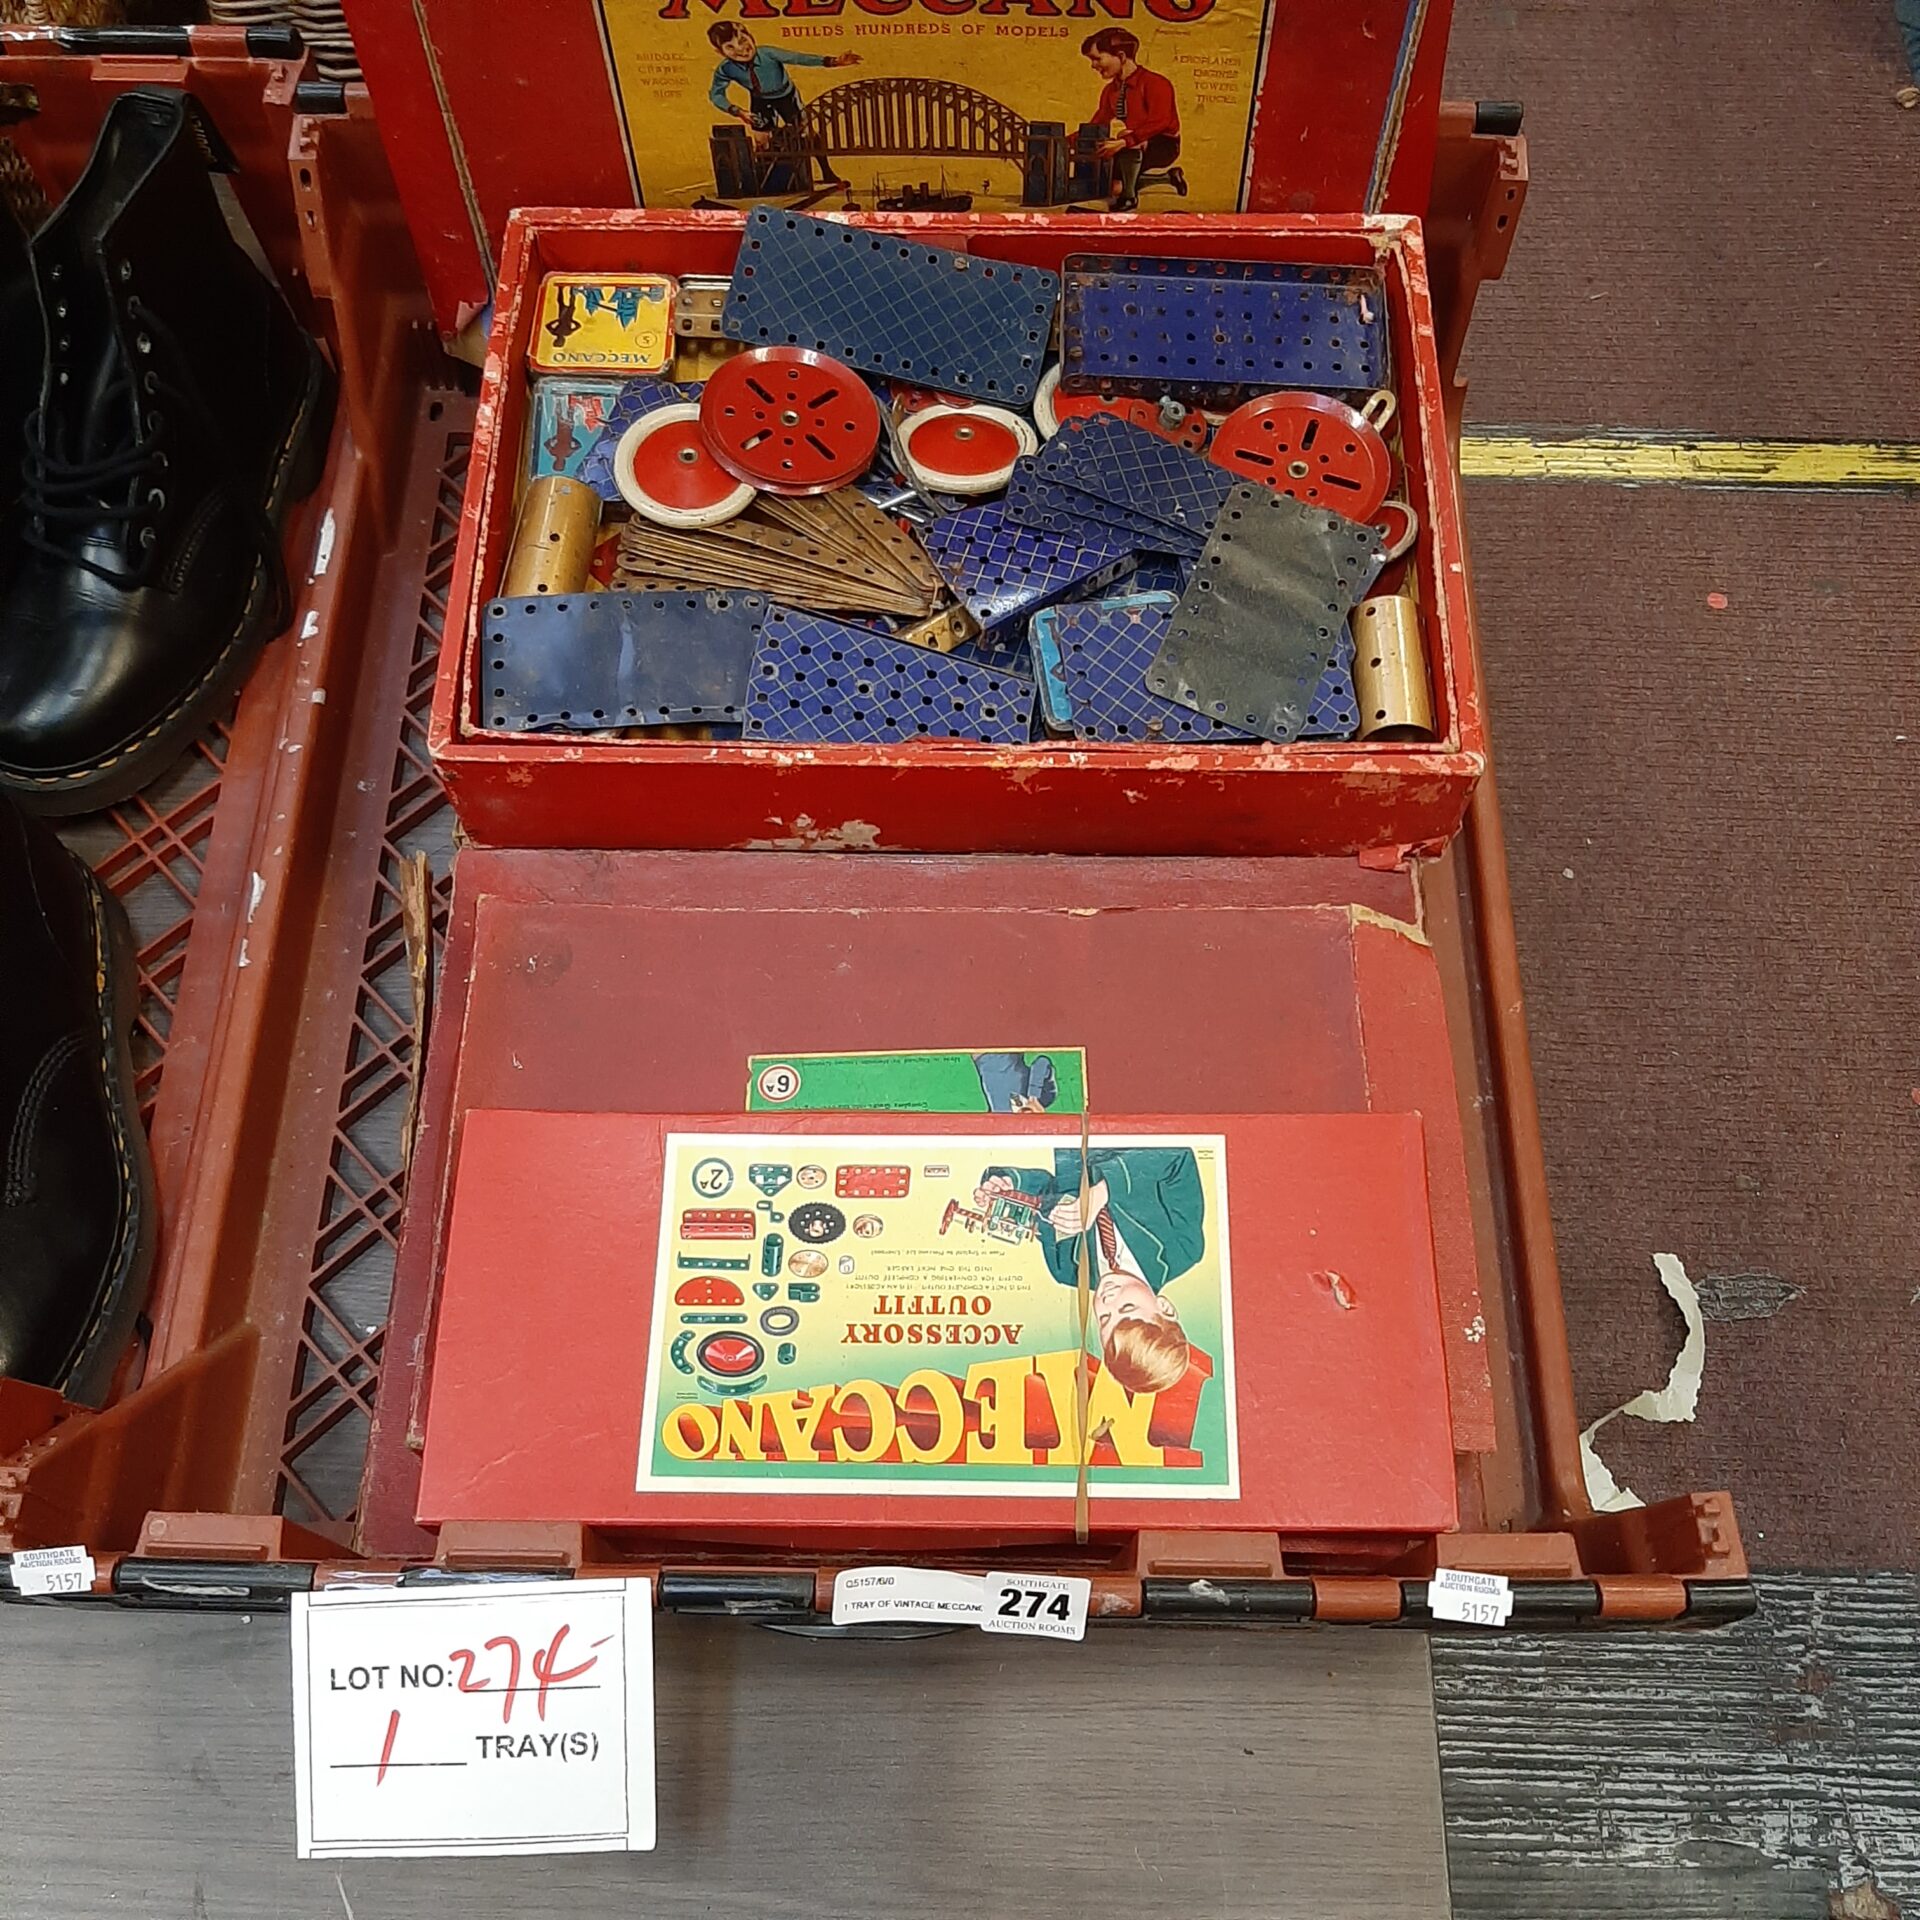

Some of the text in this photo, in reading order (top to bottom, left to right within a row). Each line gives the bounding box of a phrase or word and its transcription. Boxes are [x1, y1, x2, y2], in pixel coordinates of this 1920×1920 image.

[780, 23, 1070, 38] BUILDS HUNDREDS OF MODELS
[553, 352, 651, 363] MECCANO
[874, 1294, 991, 1316] OUTFIT
[841, 1323, 1024, 1345] ACCESSORY
[660, 1349, 1213, 1468] MECCANO
[20, 1559, 53, 1568] AUCTION
[22, 1549, 76, 1561] SOUTHGATE
[46, 1572, 82, 1591] 5157
[1006, 1578, 1069, 1590] SOUTHGATE
[1445, 1572, 1497, 1587] SOUTHGATE
[1440, 1581, 1501, 1596] AUCTION ROOMS
[851, 1601, 876, 1609] TRAY
[877, 1600, 891, 1608] OF
[893, 1600, 935, 1609] VINTAGE
[998, 1588, 1070, 1621] 274
[1462, 1602, 1499, 1624] 5157
[988, 1619, 1076, 1635] AUCTION ROOMS
[330, 1664, 453, 1690] LOT NO:
[376, 1709, 401, 1787] 1
[475, 1732, 599, 1762] TRAY(S)
